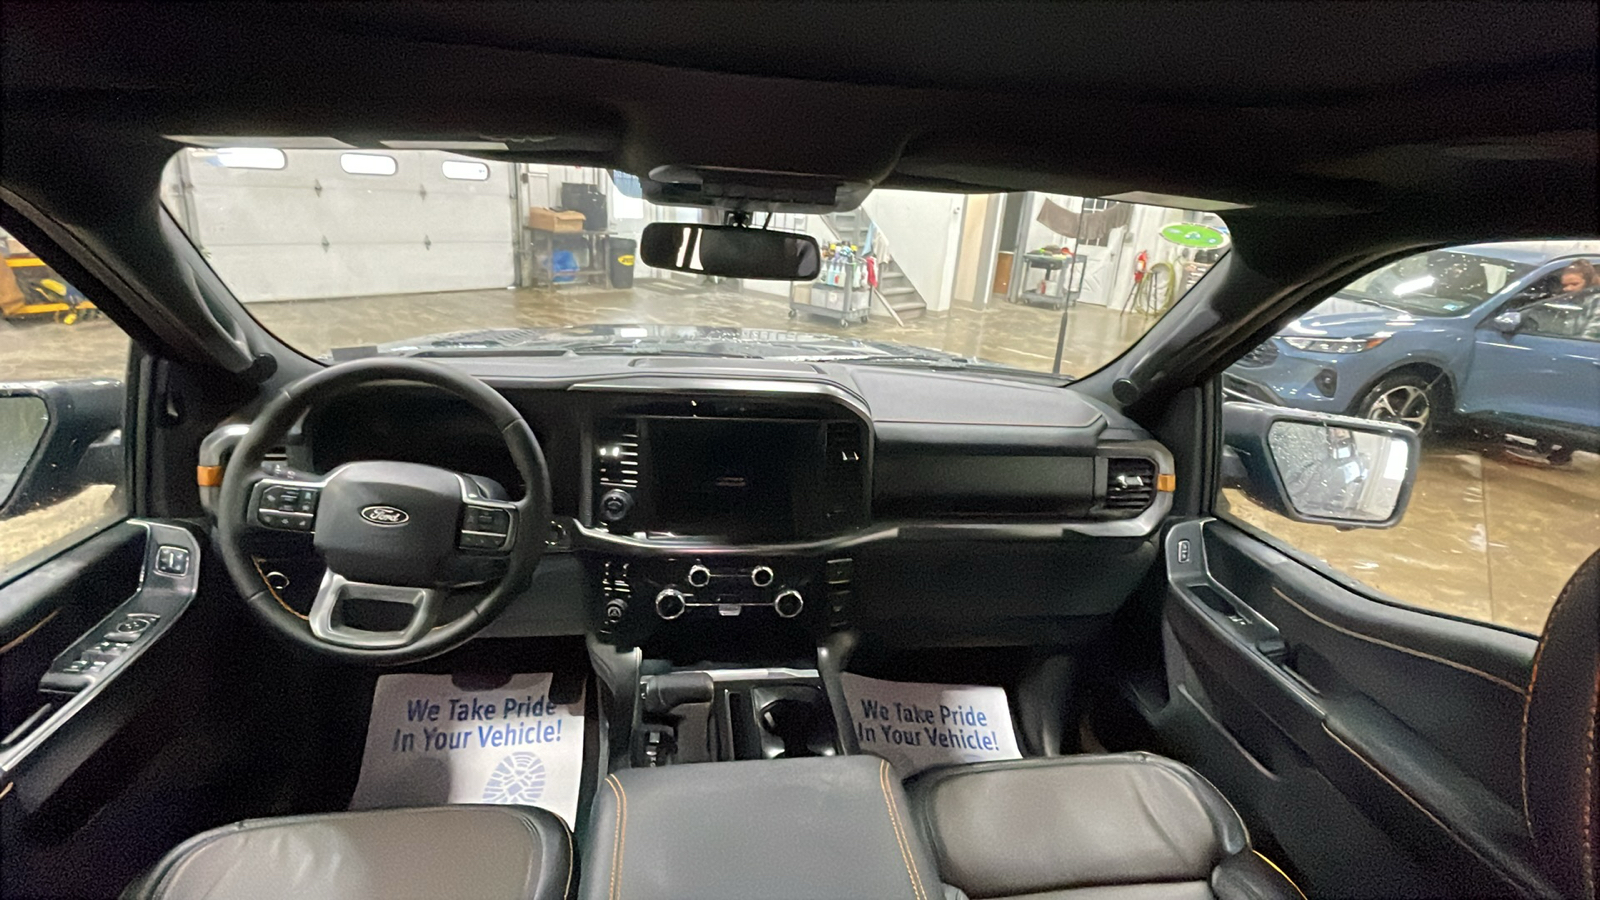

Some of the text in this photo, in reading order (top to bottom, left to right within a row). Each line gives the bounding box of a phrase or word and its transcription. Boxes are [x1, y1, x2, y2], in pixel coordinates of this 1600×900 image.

[370, 509, 400, 521] Ford
[406, 695, 557, 721] We Take Pride
[860, 699, 988, 727] We Take Pride
[392, 719, 563, 750] In Your Vehicle!
[857, 722, 1000, 751] In Your Vehicle!
